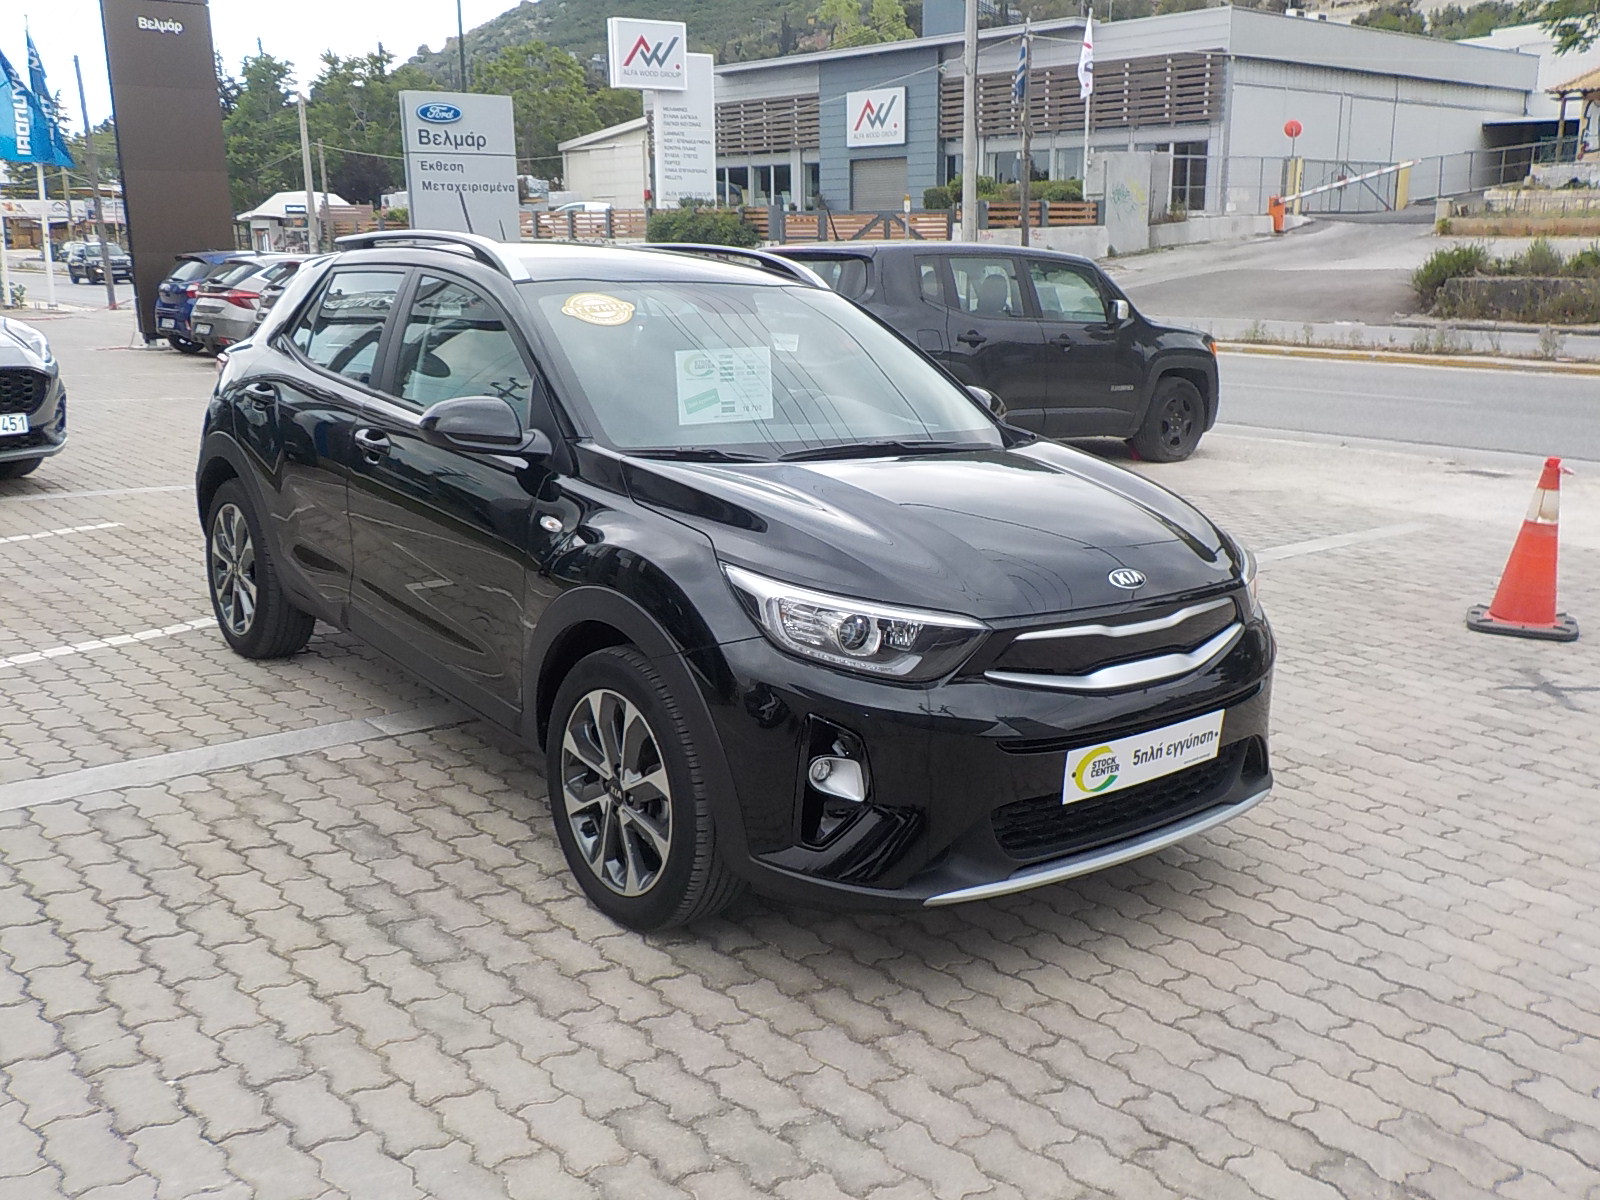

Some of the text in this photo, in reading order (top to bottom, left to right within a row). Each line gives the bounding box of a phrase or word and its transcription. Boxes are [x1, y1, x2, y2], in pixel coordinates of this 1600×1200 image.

[137, 16, 183, 35] Βελμάρ
[427, 106, 454, 119] Ford
[418, 129, 487, 150] Βελμάρ
[418, 160, 464, 173] Έκθεση
[422, 181, 515, 194] Μεταχειρισμένα
[2, 416, 25, 431] 451
[1114, 570, 1144, 585] KIA
[1166, 731, 1214, 758] εγγύηση
[1091, 763, 1120, 778] CENTER
[1092, 756, 1117, 770] STOCK
